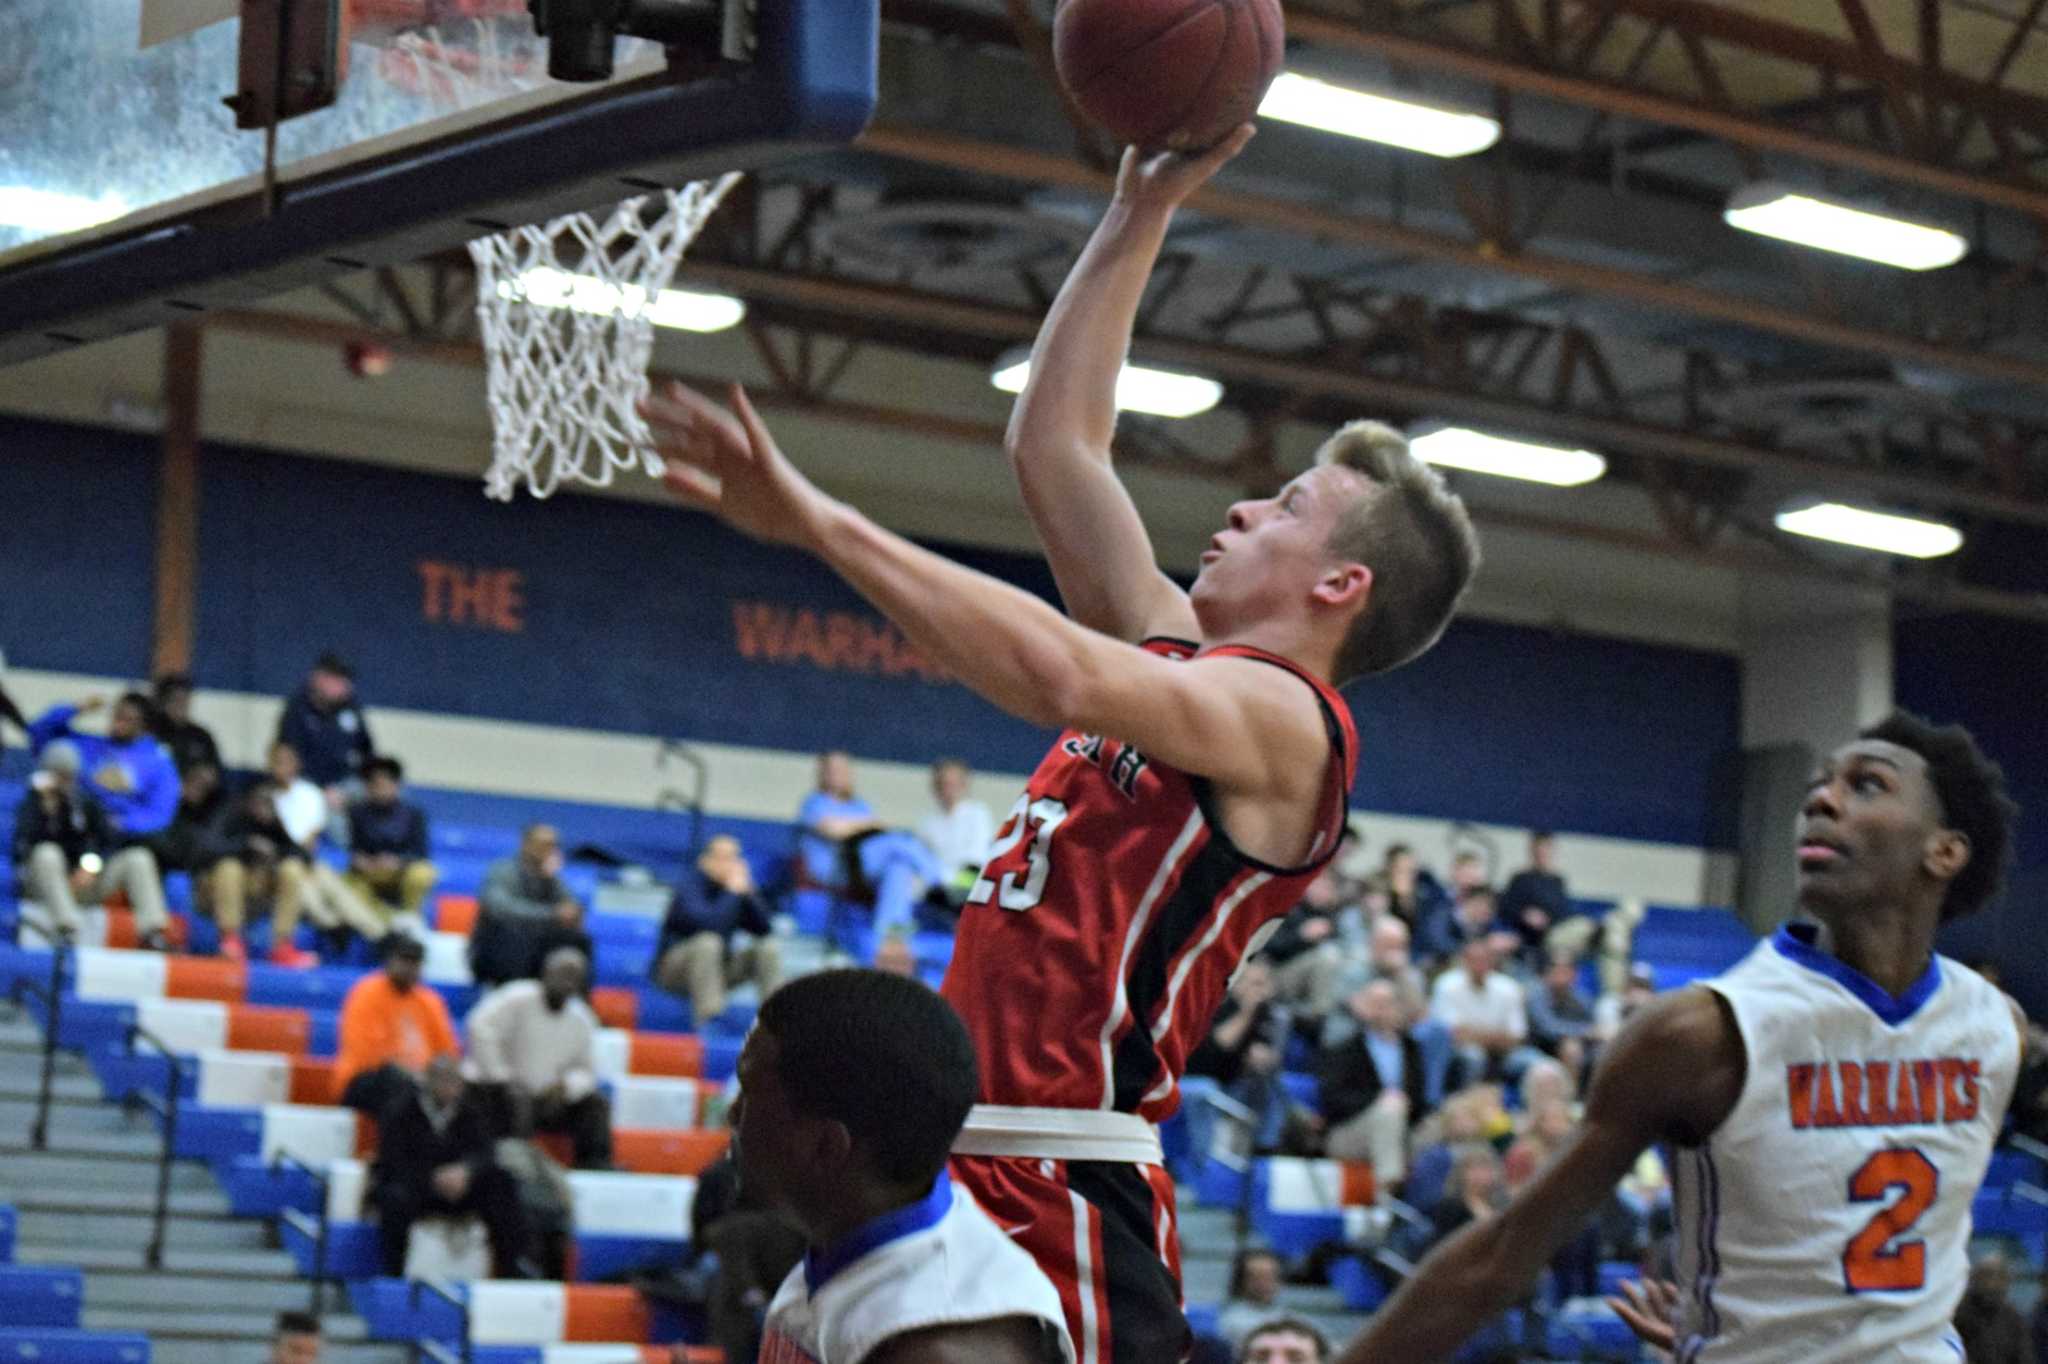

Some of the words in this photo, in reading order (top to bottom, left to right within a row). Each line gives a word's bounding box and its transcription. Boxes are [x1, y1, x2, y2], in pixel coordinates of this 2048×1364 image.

[416, 560, 526, 630] THE
[732, 602, 955, 682] WARHA
[967, 792, 1068, 911] 23
[1787, 1058, 1981, 1129] WARHAWKS
[1843, 1148, 1940, 1294] 2
